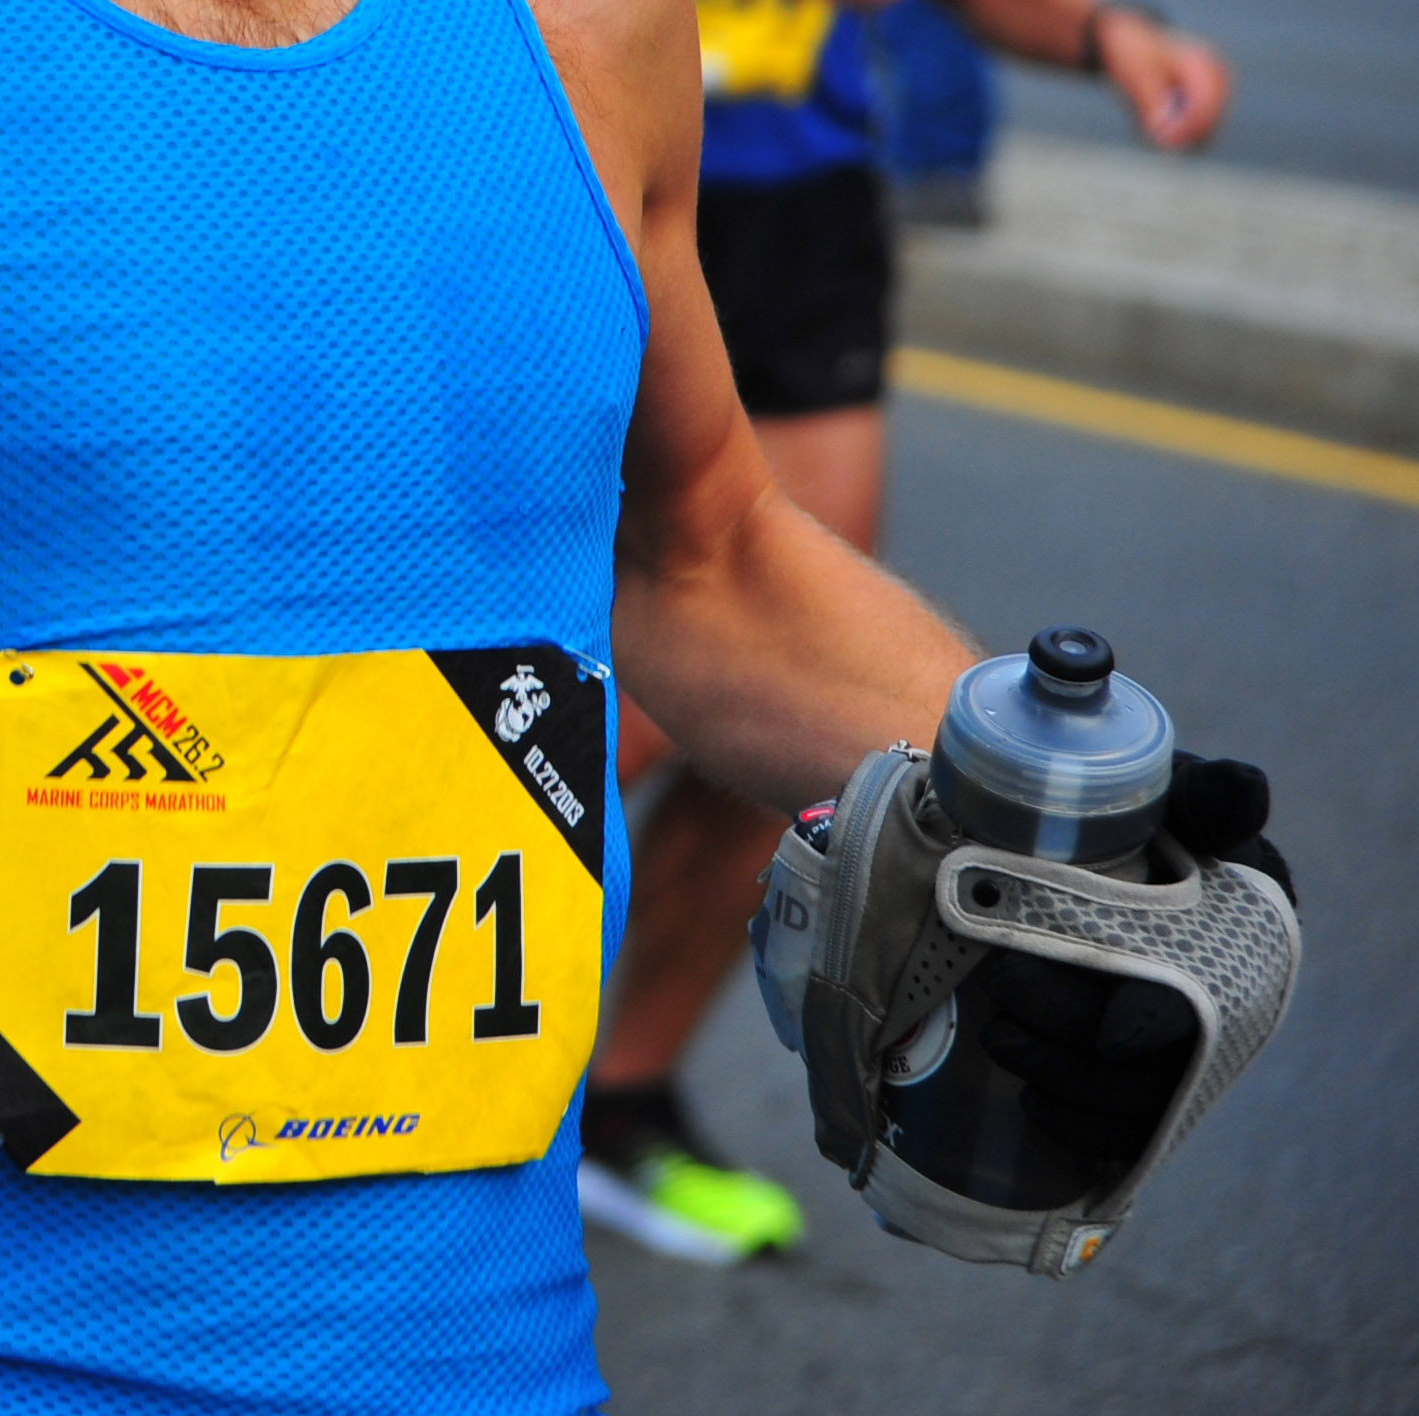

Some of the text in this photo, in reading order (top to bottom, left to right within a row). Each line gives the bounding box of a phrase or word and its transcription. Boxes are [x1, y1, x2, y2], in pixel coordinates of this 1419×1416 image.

[27, 787, 226, 813] MARINE CORPS MARATHON
[524, 745, 585, 827] 10.27.2013
[774, 888, 810, 932] ID
[63, 849, 541, 1056] 15671
[274, 1113, 420, 1140] BOEING
